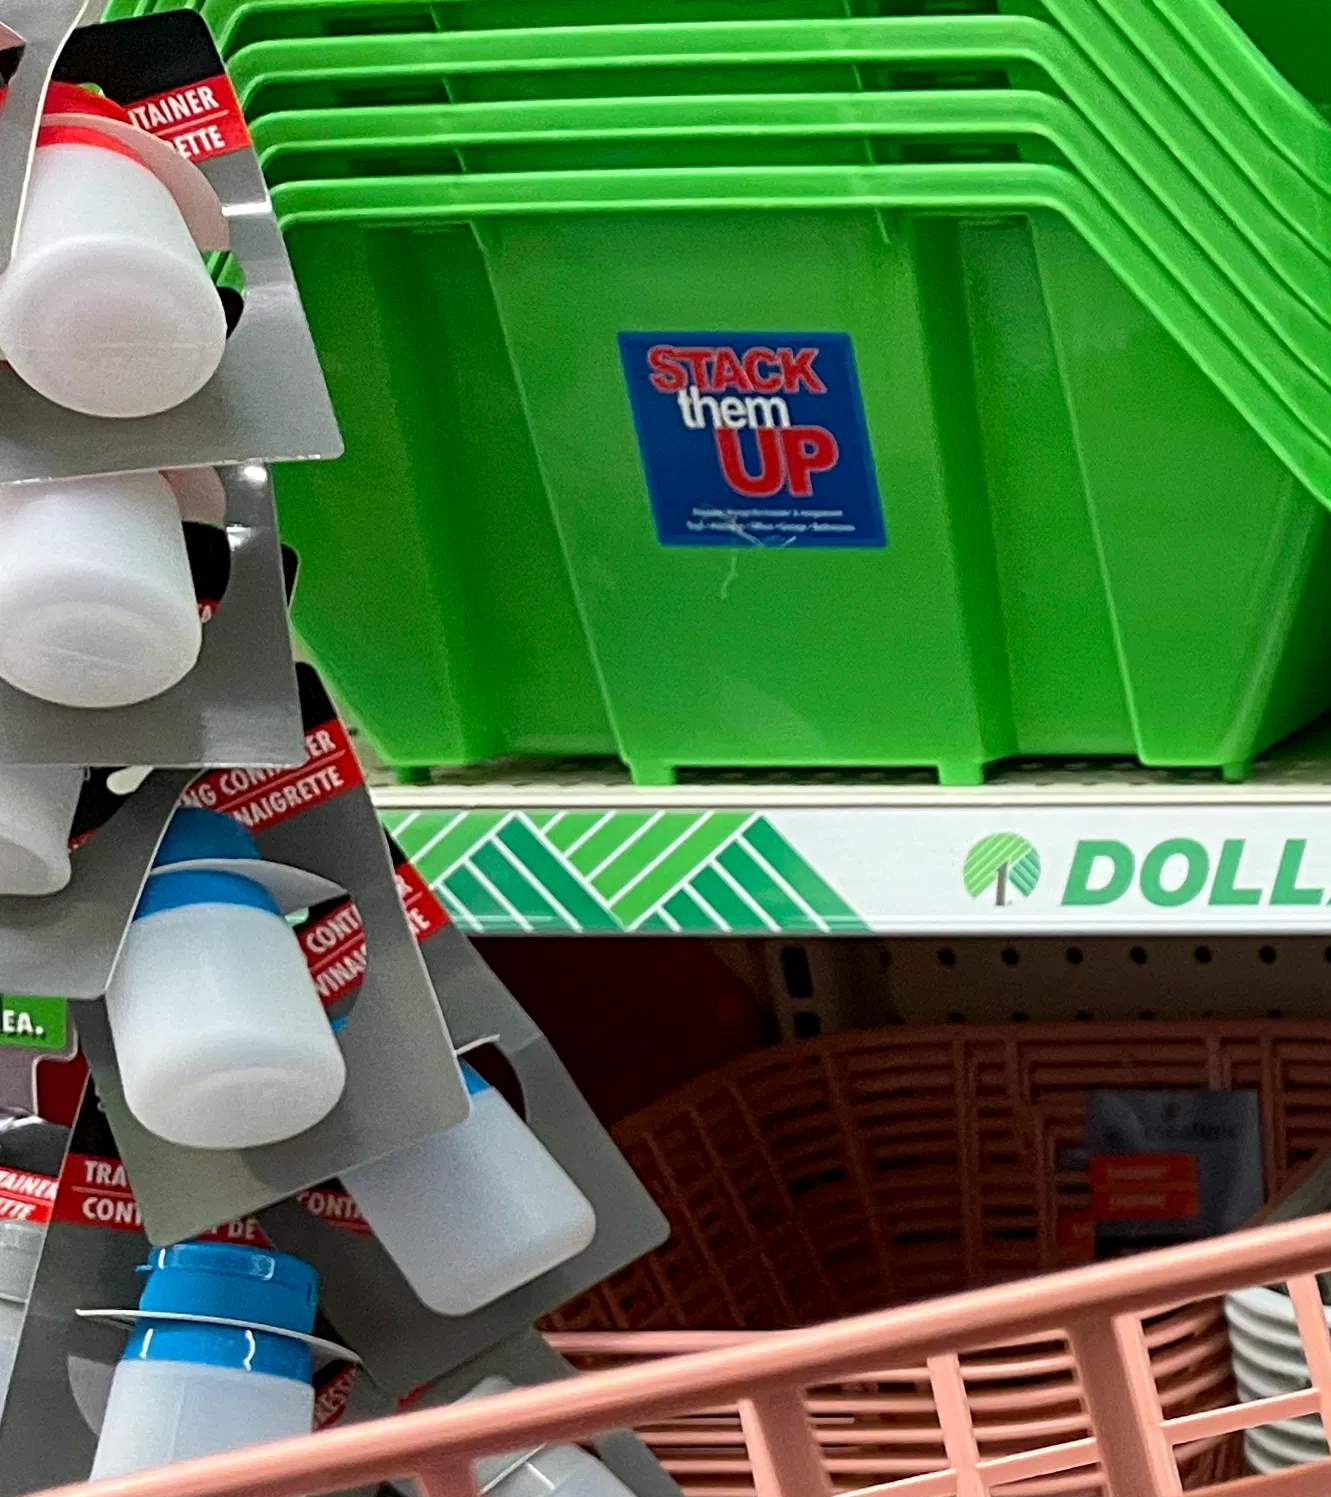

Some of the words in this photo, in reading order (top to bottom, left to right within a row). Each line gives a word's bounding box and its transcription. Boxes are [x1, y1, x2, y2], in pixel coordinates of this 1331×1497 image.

[170, 125, 226, 159] ETTE
[647, 344, 828, 394] STACK
[677, 384, 791, 429] them
[714, 425, 840, 498] UP
[232, 765, 345, 827] NAIGRETTE
[2, 1009, 44, 1035] EA.
[84, 1160, 128, 1188] TRA
